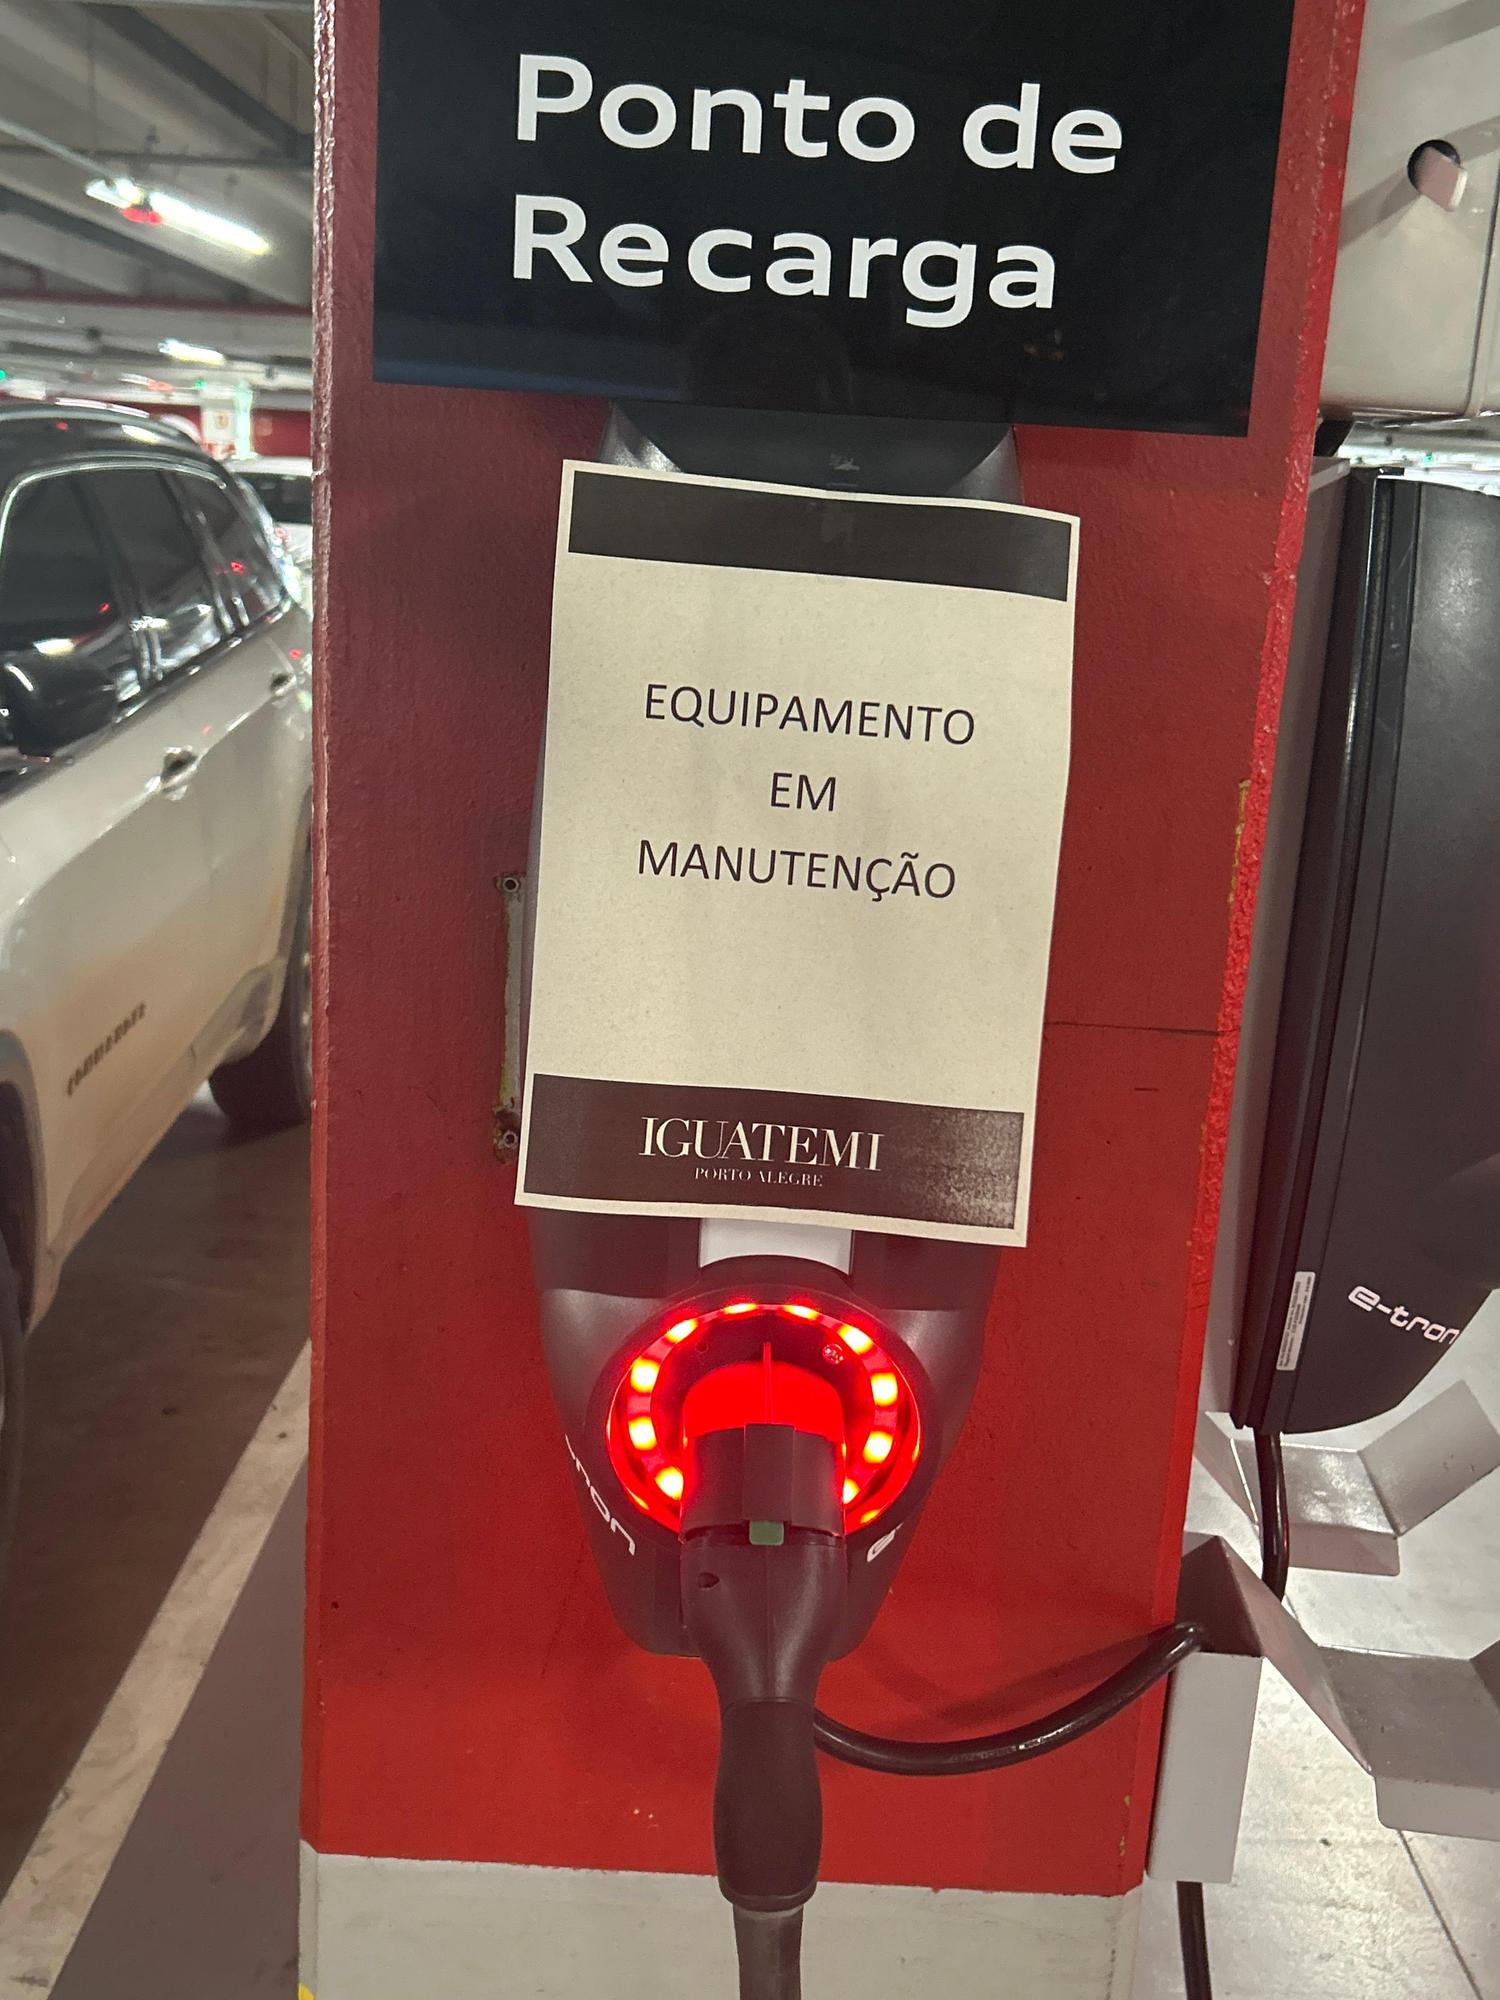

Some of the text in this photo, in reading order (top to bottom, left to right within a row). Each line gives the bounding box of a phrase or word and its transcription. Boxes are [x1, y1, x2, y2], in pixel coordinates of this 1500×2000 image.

[515, 53, 1123, 175] Ponto de
[512, 193, 1057, 328] Recarga
[645, 683, 975, 745] EQUIPAMENTO
[770, 772, 836, 812] EM
[638, 839, 956, 902] MANUTENÇÃO
[638, 1116, 885, 1172] IGUATEMI
[694, 1167, 752, 1181] PORTO
[758, 1170, 824, 1187] ALEGRE
[1348, 1285, 1460, 1345] e-tron
